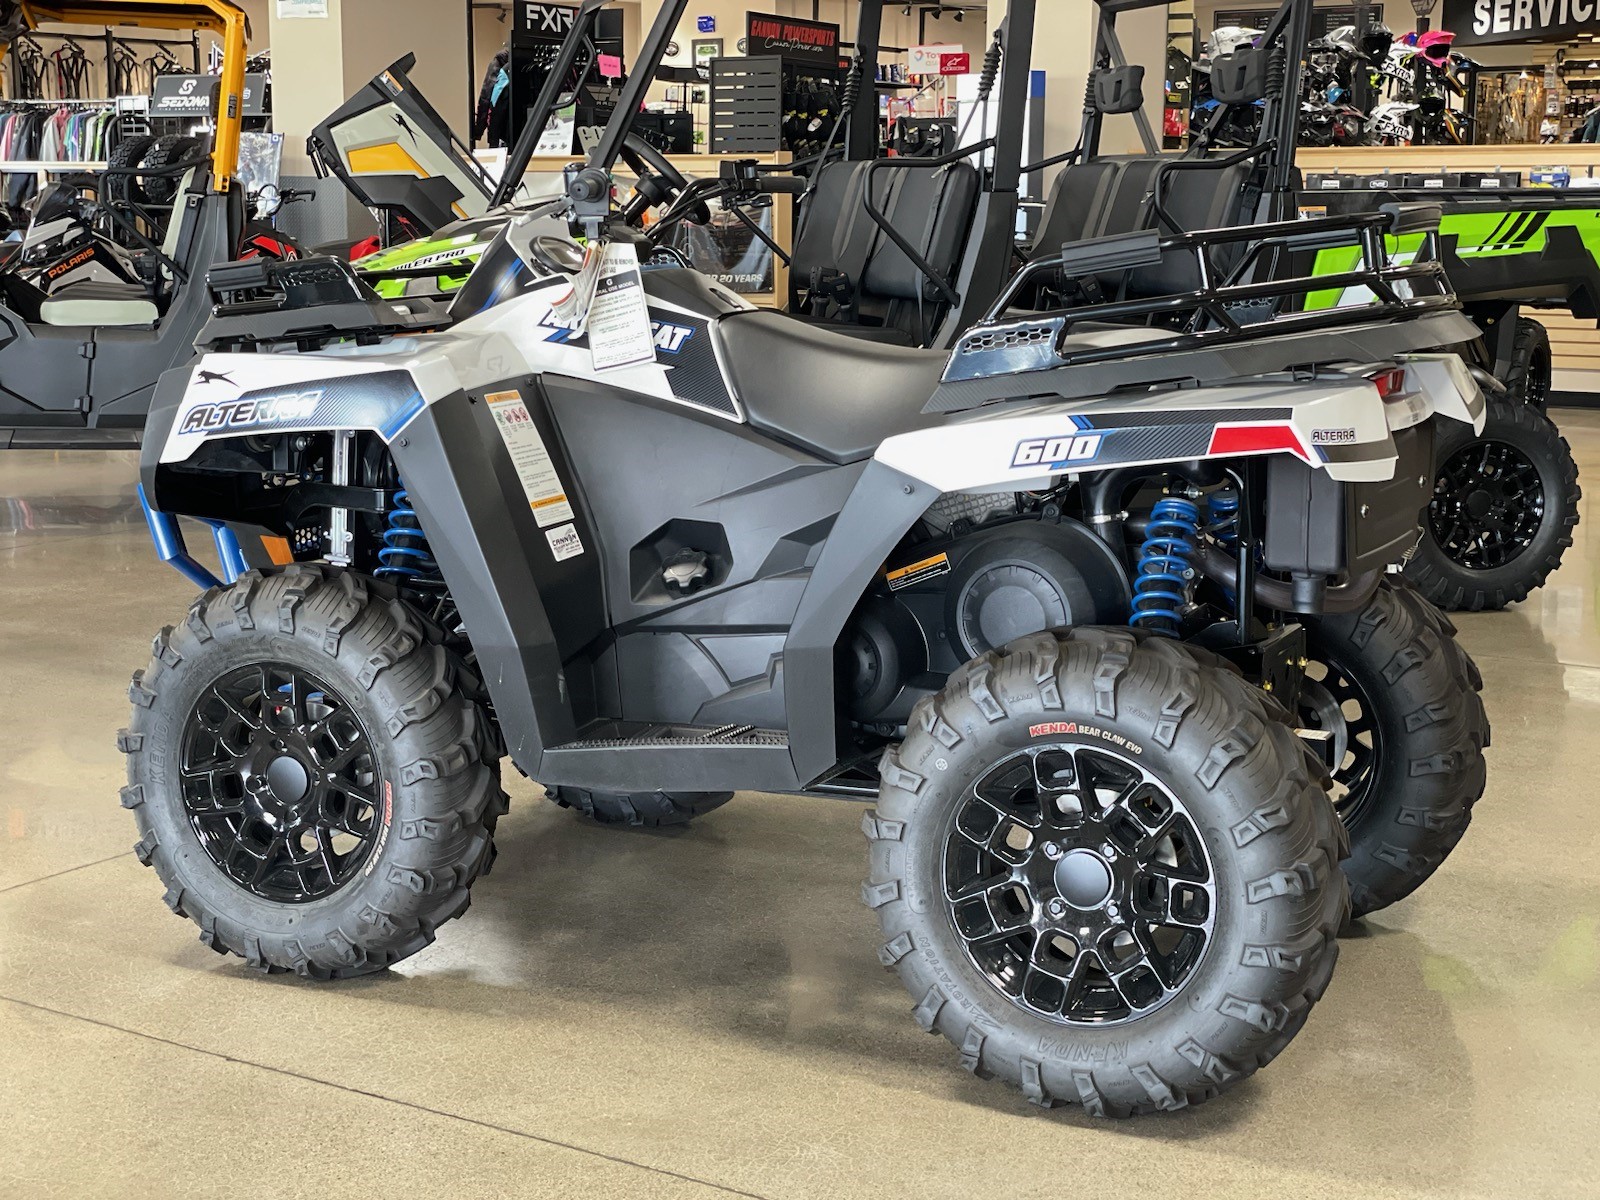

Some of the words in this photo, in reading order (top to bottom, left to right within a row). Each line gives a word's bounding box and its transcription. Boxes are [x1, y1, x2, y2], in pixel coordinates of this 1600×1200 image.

[526, 4, 574, 33] FXR
[1473, 0, 1600, 36] SERVIC
[751, 20, 781, 39] CANNON
[783, 25, 835, 46] POWERSPORTS
[157, 96, 210, 107] SEDONA
[48, 248, 95, 278] POLARIS
[436, 249, 465, 261] PRO
[718, 273, 733, 283] 20
[182, 390, 321, 431] ALTER
[1312, 429, 1355, 441] ALTERRA
[1013, 434, 1102, 465] 600
[1029, 722, 1078, 737] KENDA
[1078, 725, 1101, 737] BEAR
[1101, 731, 1127, 746] CLAW
[1125, 741, 1143, 755] EVO
[1036, 1035, 1129, 1062] KENDA
